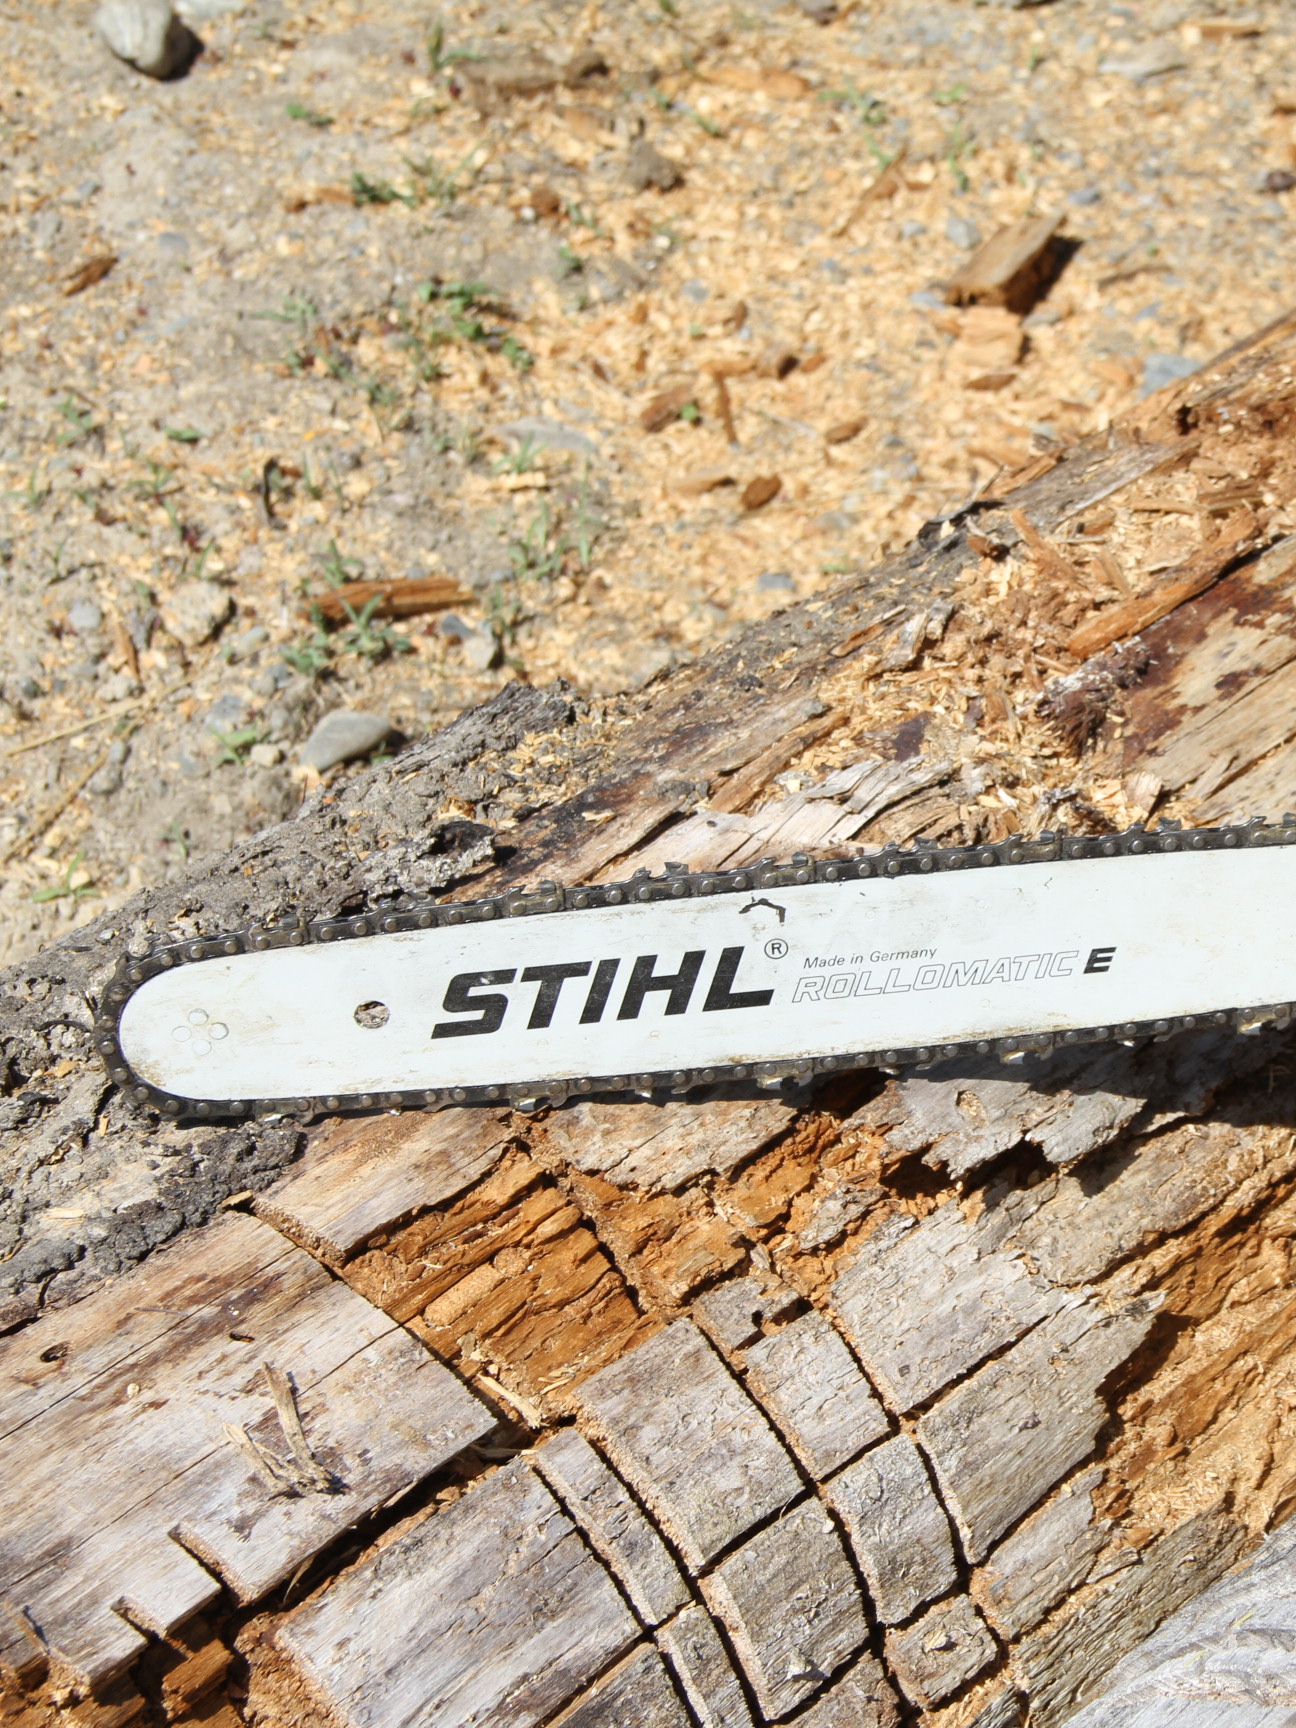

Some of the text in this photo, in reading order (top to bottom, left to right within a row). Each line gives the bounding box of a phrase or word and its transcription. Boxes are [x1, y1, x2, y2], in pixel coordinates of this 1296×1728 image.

[792, 947, 1117, 1003] ROLLOMATIC E
[803, 947, 938, 969] Made in Germany
[431, 945, 775, 1039] STIHL
